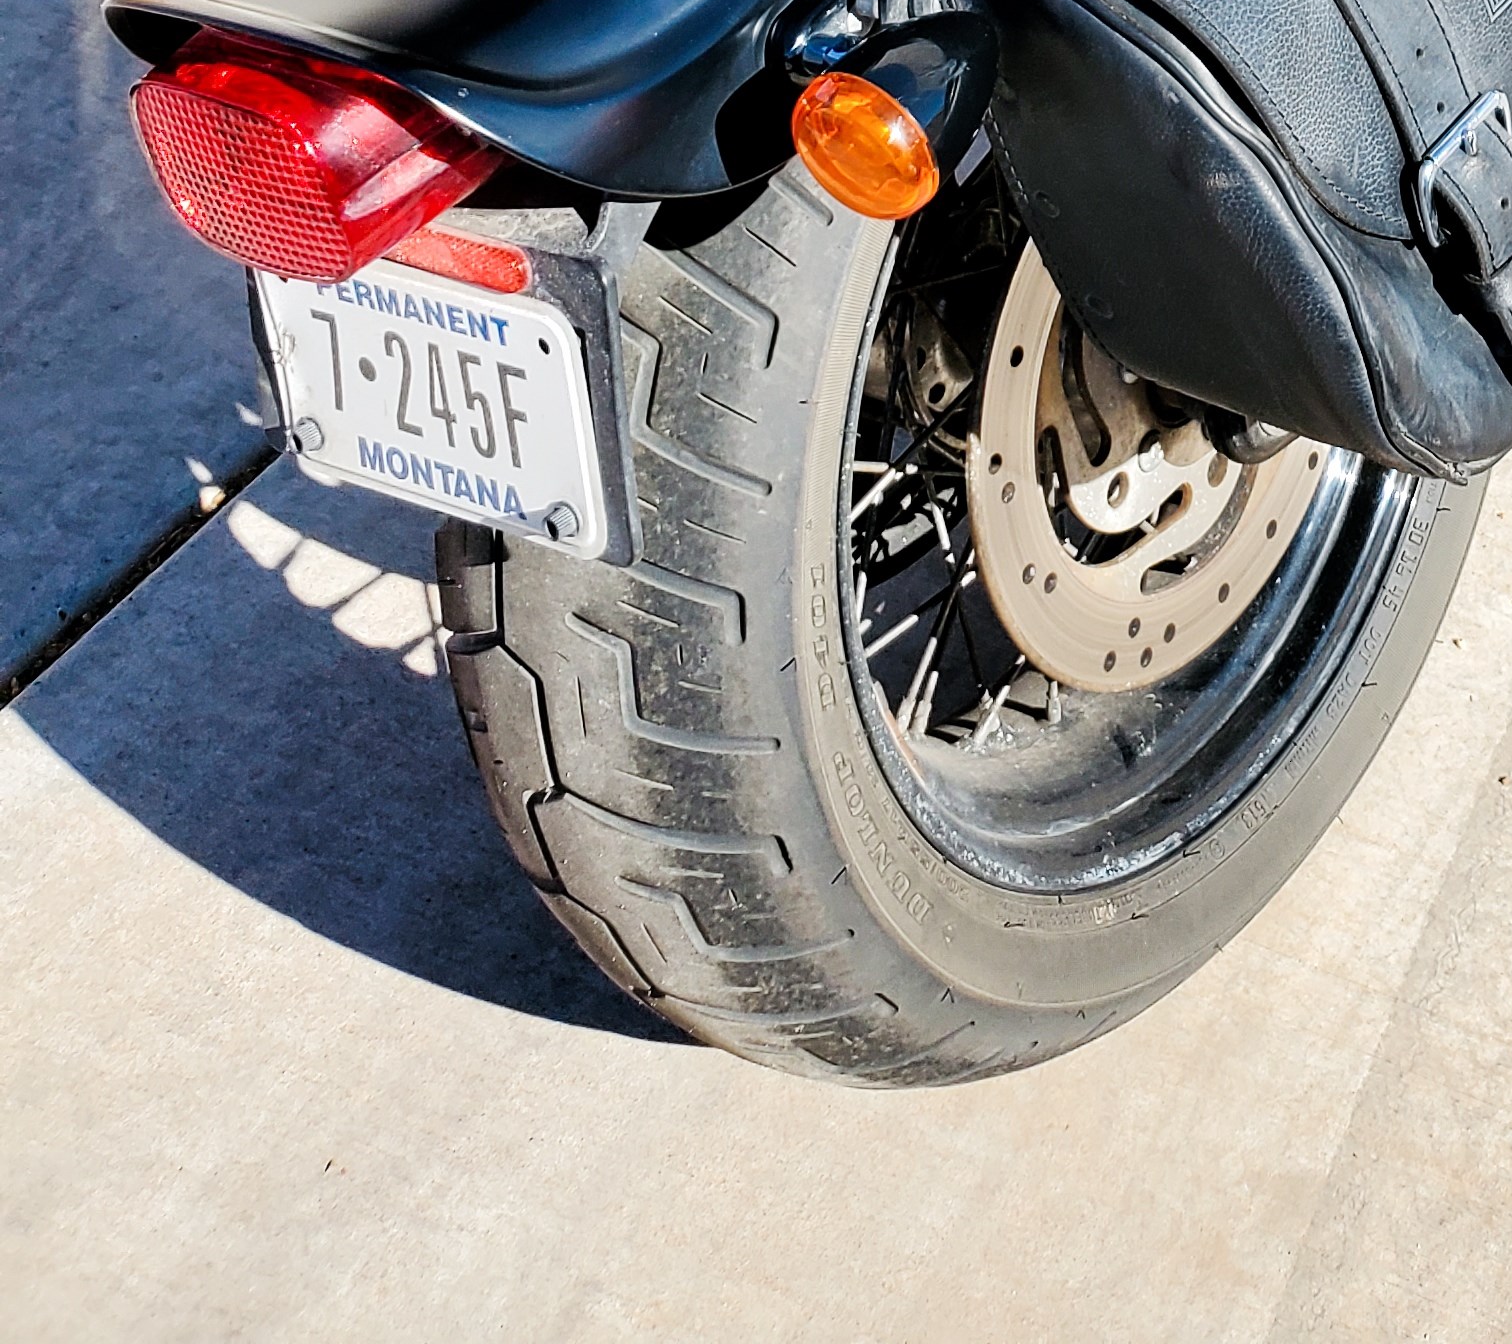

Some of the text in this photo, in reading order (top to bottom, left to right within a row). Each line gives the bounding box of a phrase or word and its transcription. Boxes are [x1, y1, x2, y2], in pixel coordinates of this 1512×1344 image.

[357, 436, 527, 521] MONTANA
[811, 562, 934, 926] DUNLOP D401
